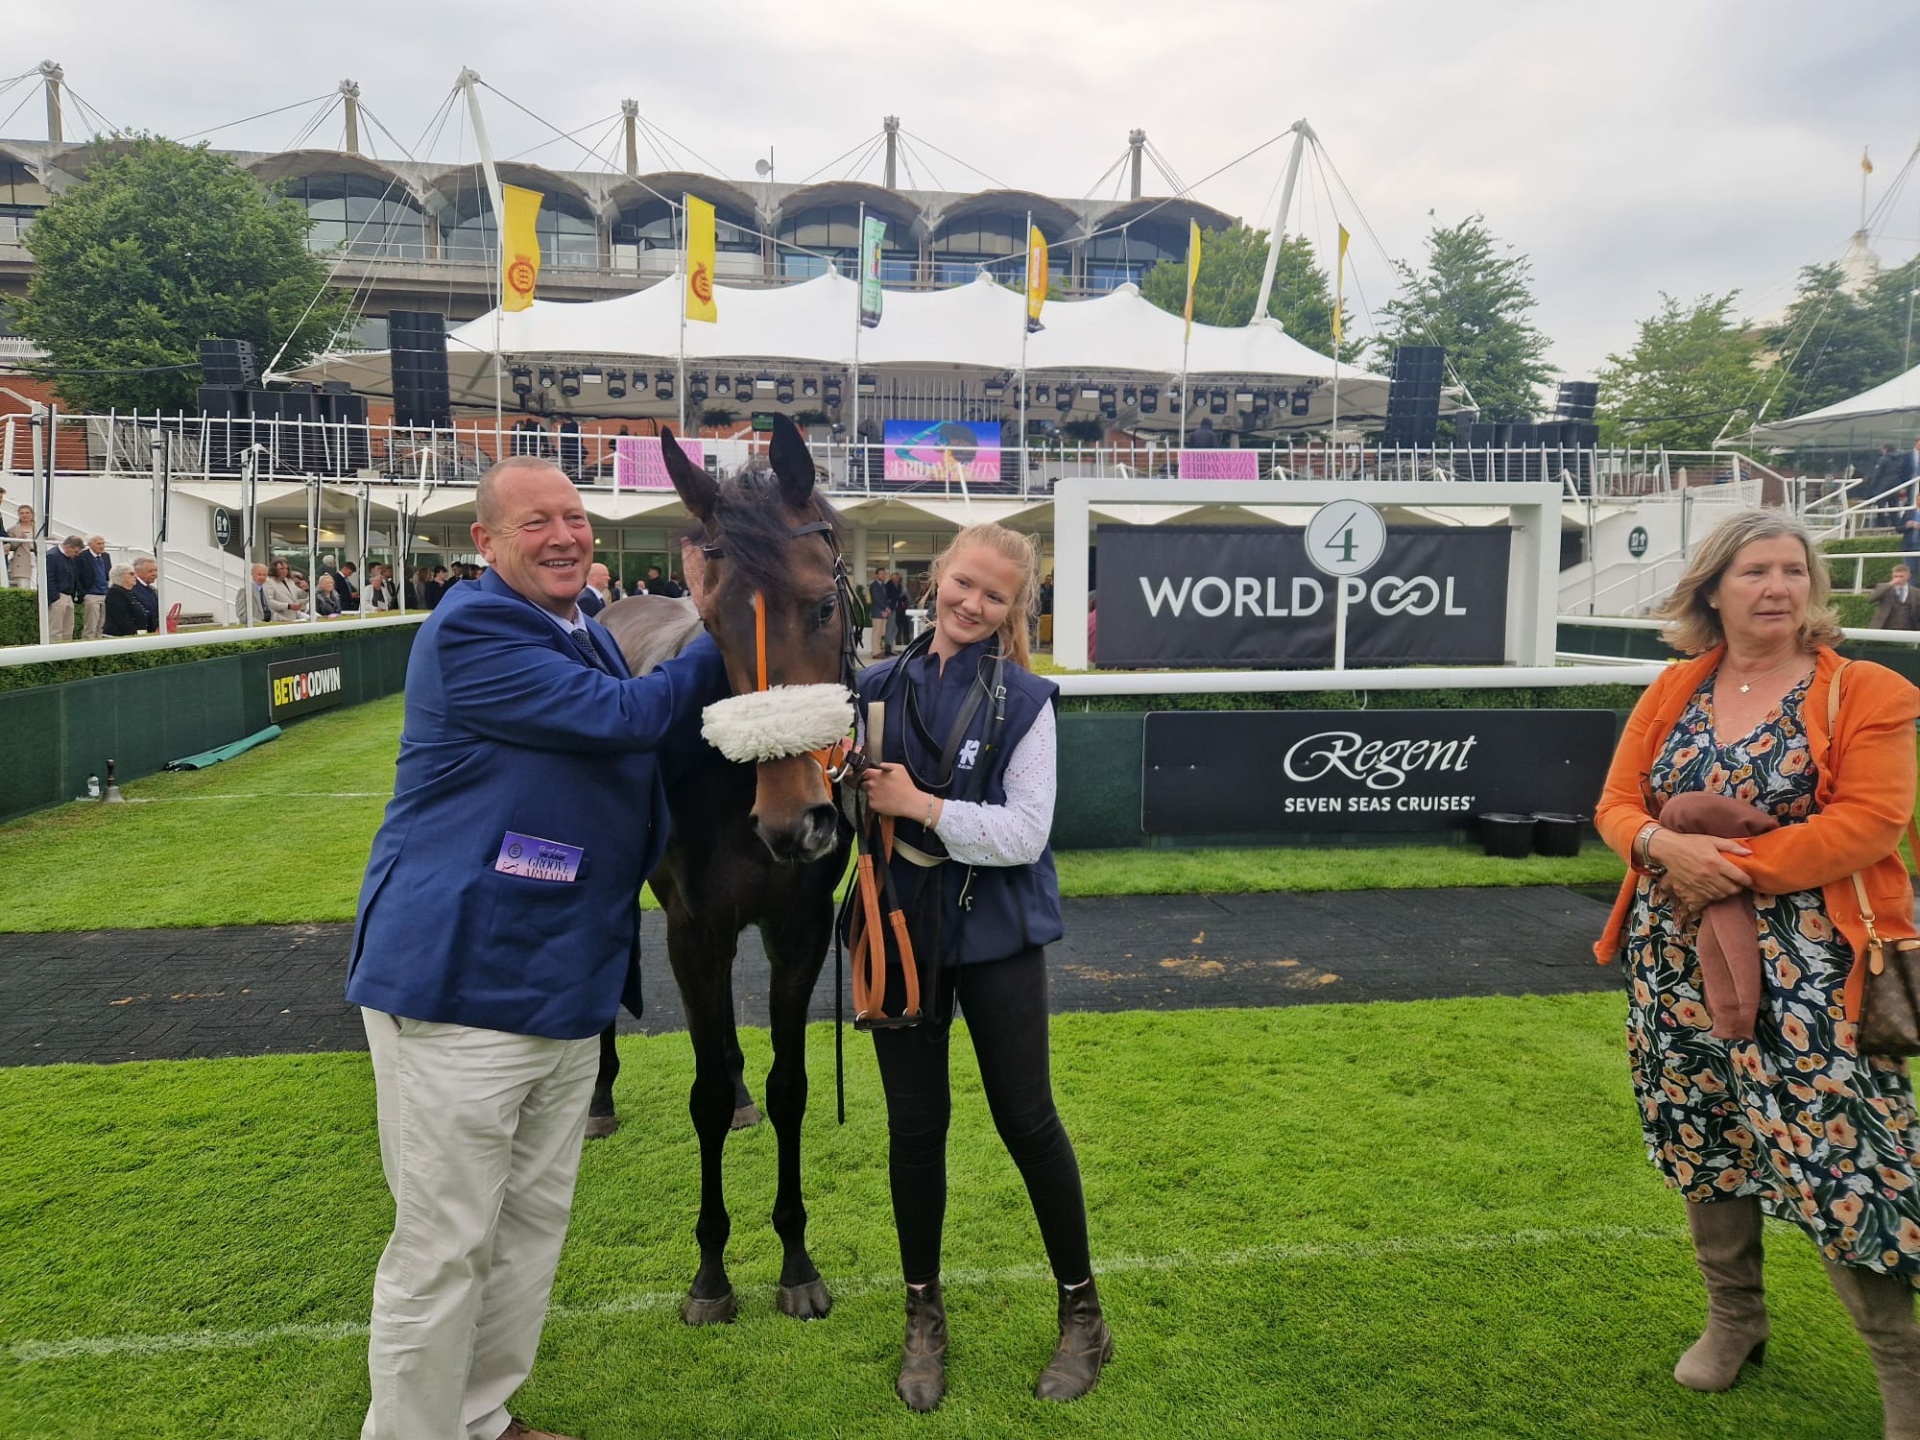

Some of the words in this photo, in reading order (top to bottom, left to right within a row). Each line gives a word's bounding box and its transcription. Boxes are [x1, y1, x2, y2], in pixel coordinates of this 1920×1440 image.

[1324, 512, 1359, 562] 4
[1139, 576, 1324, 617] WORLD
[1342, 575, 1467, 617] POOL
[1283, 731, 1477, 790] Regent
[1285, 797, 1341, 812] SEVEN
[1348, 797, 1391, 812] SEAS
[528, 856, 571, 874] GROOVE
